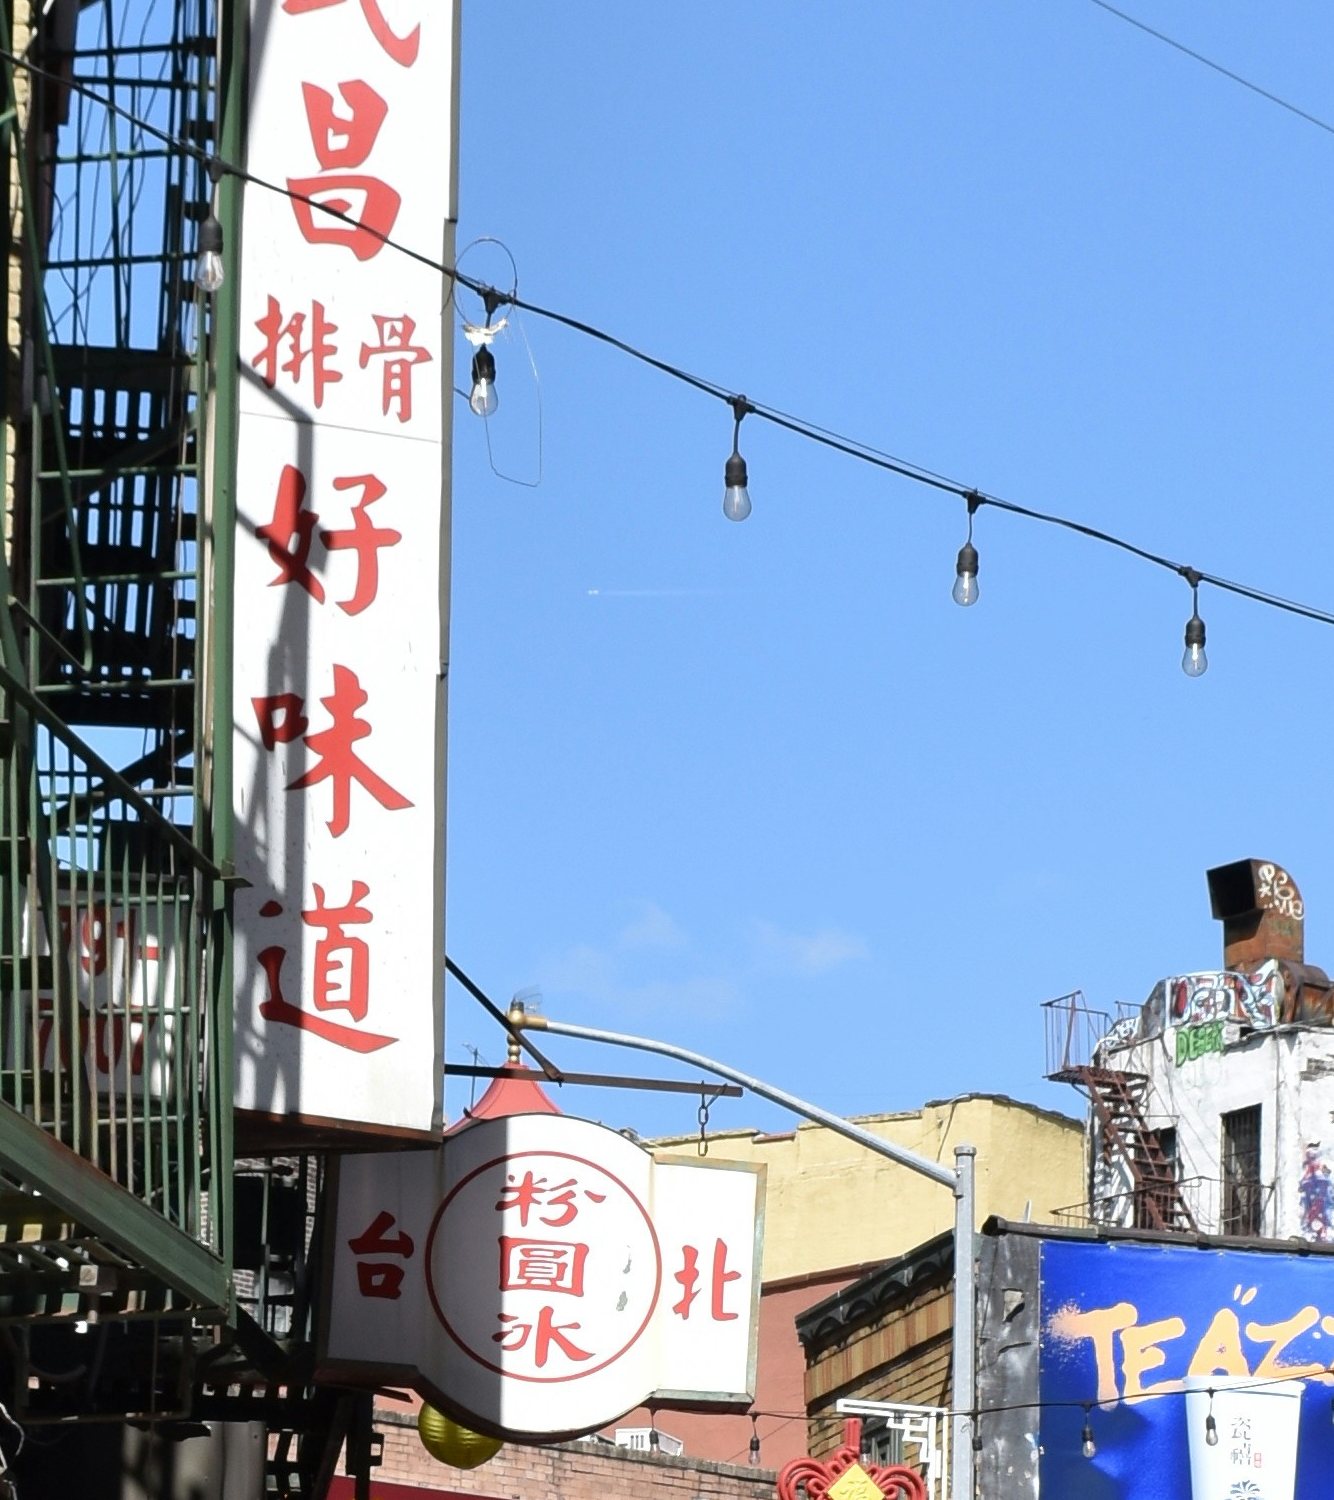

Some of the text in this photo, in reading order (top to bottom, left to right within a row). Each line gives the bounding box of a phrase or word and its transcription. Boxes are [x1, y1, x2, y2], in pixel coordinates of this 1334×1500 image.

[252, 295, 433, 423] 排骨
[250, 463, 416, 1054] 好味道
[348, 1210, 742, 1321] 台 北
